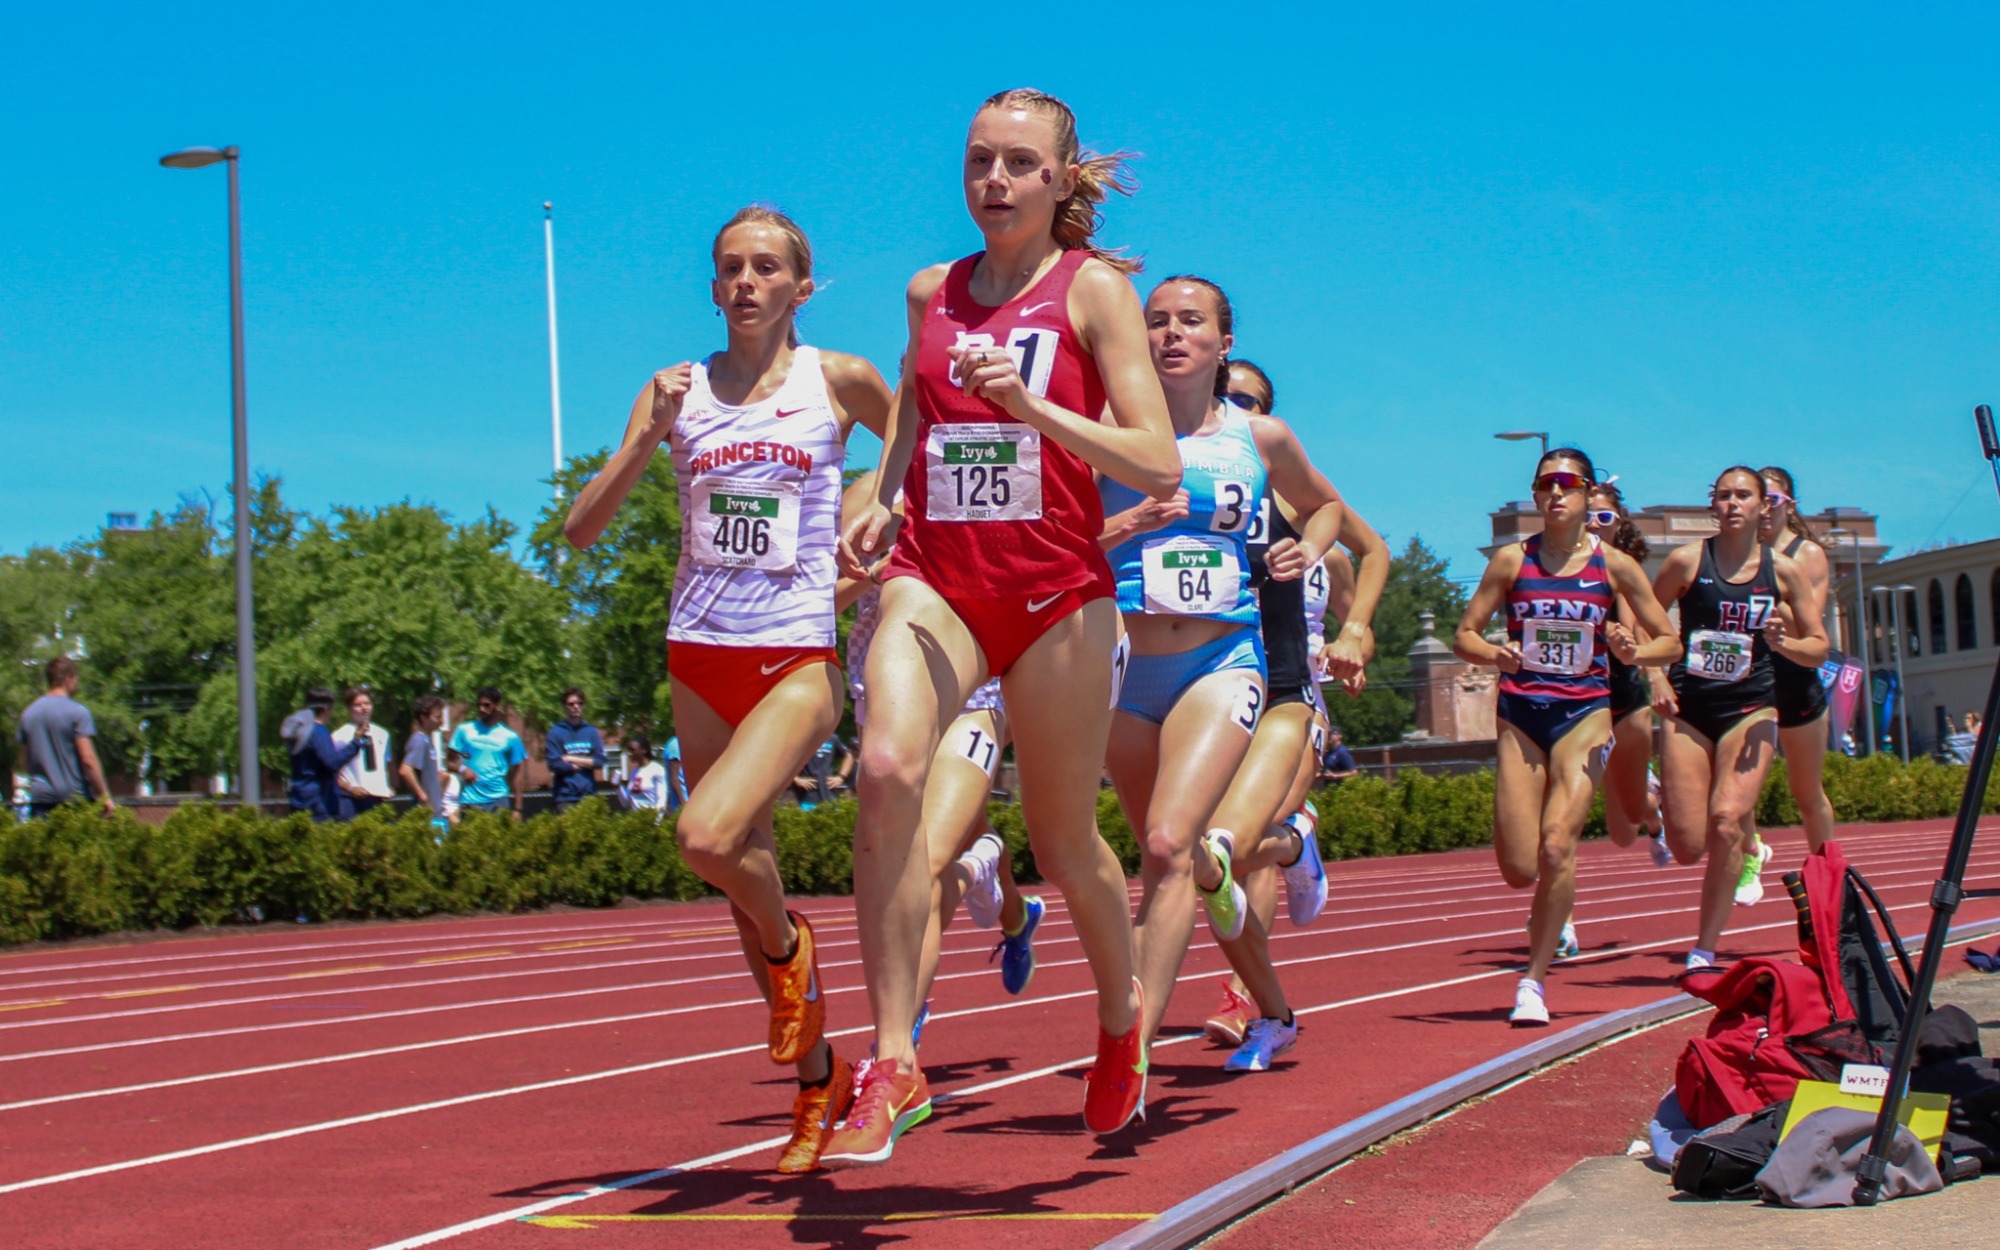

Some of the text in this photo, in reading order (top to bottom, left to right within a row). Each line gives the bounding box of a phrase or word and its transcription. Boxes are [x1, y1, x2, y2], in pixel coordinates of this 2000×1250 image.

[1014, 333, 1040, 389] 1
[692, 441, 812, 476] PRINCETON
[960, 445, 984, 462] Ivy
[951, 466, 1010, 507] 125
[725, 497, 750, 514] Ivy
[1218, 484, 1244, 531] 3
[713, 516, 770, 556] 406
[1178, 552, 1198, 566] Ivy
[1178, 569, 1212, 602] 64
[1309, 565, 1325, 597] 4
[1513, 599, 1607, 626] PENN
[1719, 601, 1749, 634] H
[1753, 599, 1771, 628] 7
[1539, 643, 1575, 666] 331
[1703, 652, 1736, 674] 266
[1239, 685, 1262, 730] 3
[967, 730, 995, 771] 11
